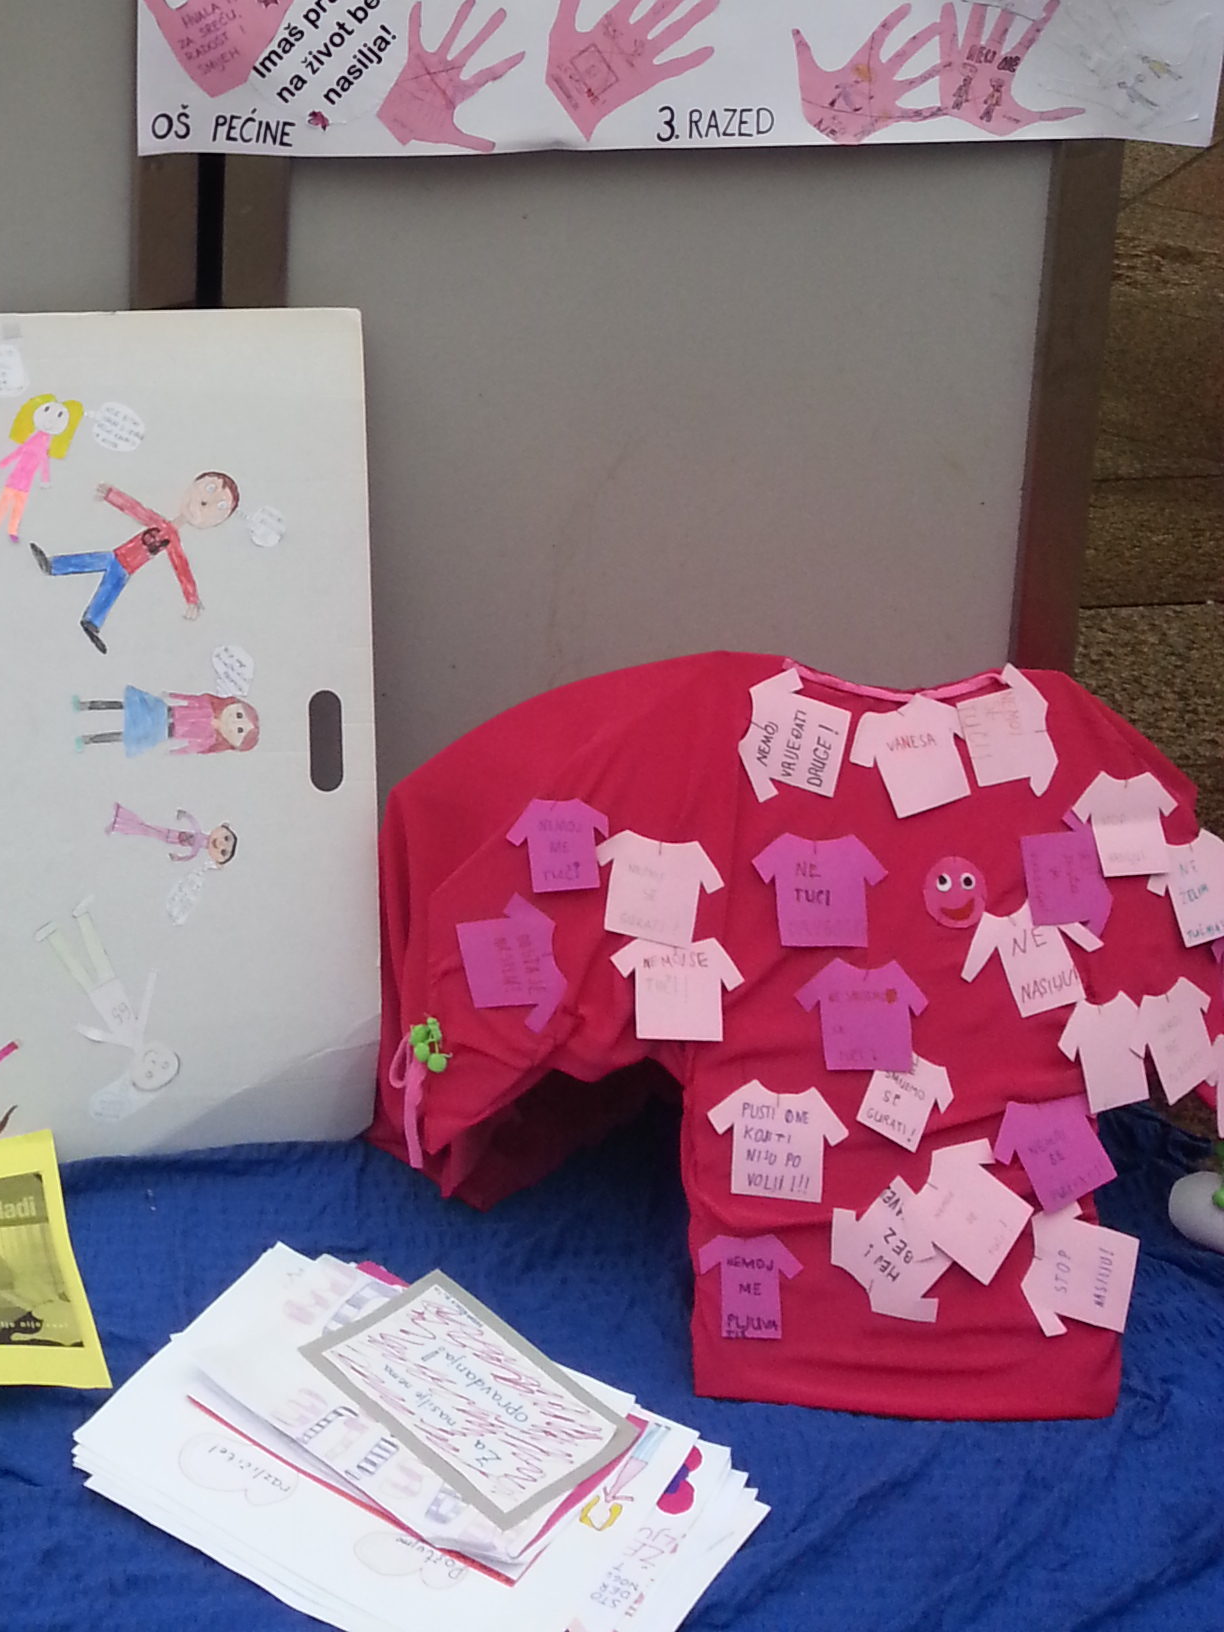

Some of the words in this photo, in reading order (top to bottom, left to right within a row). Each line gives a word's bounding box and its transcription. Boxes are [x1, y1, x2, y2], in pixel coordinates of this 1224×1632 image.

[252, 23, 305, 80] Imaš
[276, 74, 308, 105] na
[304, 13, 355, 79] život
[322, 24, 398, 107] nasilja!
[151, 103, 192, 140] OŠ
[211, 109, 294, 147] PEĆINE
[656, 106, 681, 143] 3.
[687, 106, 775, 139] RAZED
[756, 721, 780, 767] NEMOJ
[885, 732, 937, 752] VANESA
[806, 738, 832, 788] DRUGE
[794, 862, 822, 878] NE
[1012, 928, 1048, 957] NE
[742, 1102, 775, 1120] PUSTI
[785, 1109, 809, 1124] ONE
[785, 1152, 801, 1168] PO
[739, 1283, 761, 1296] ME
